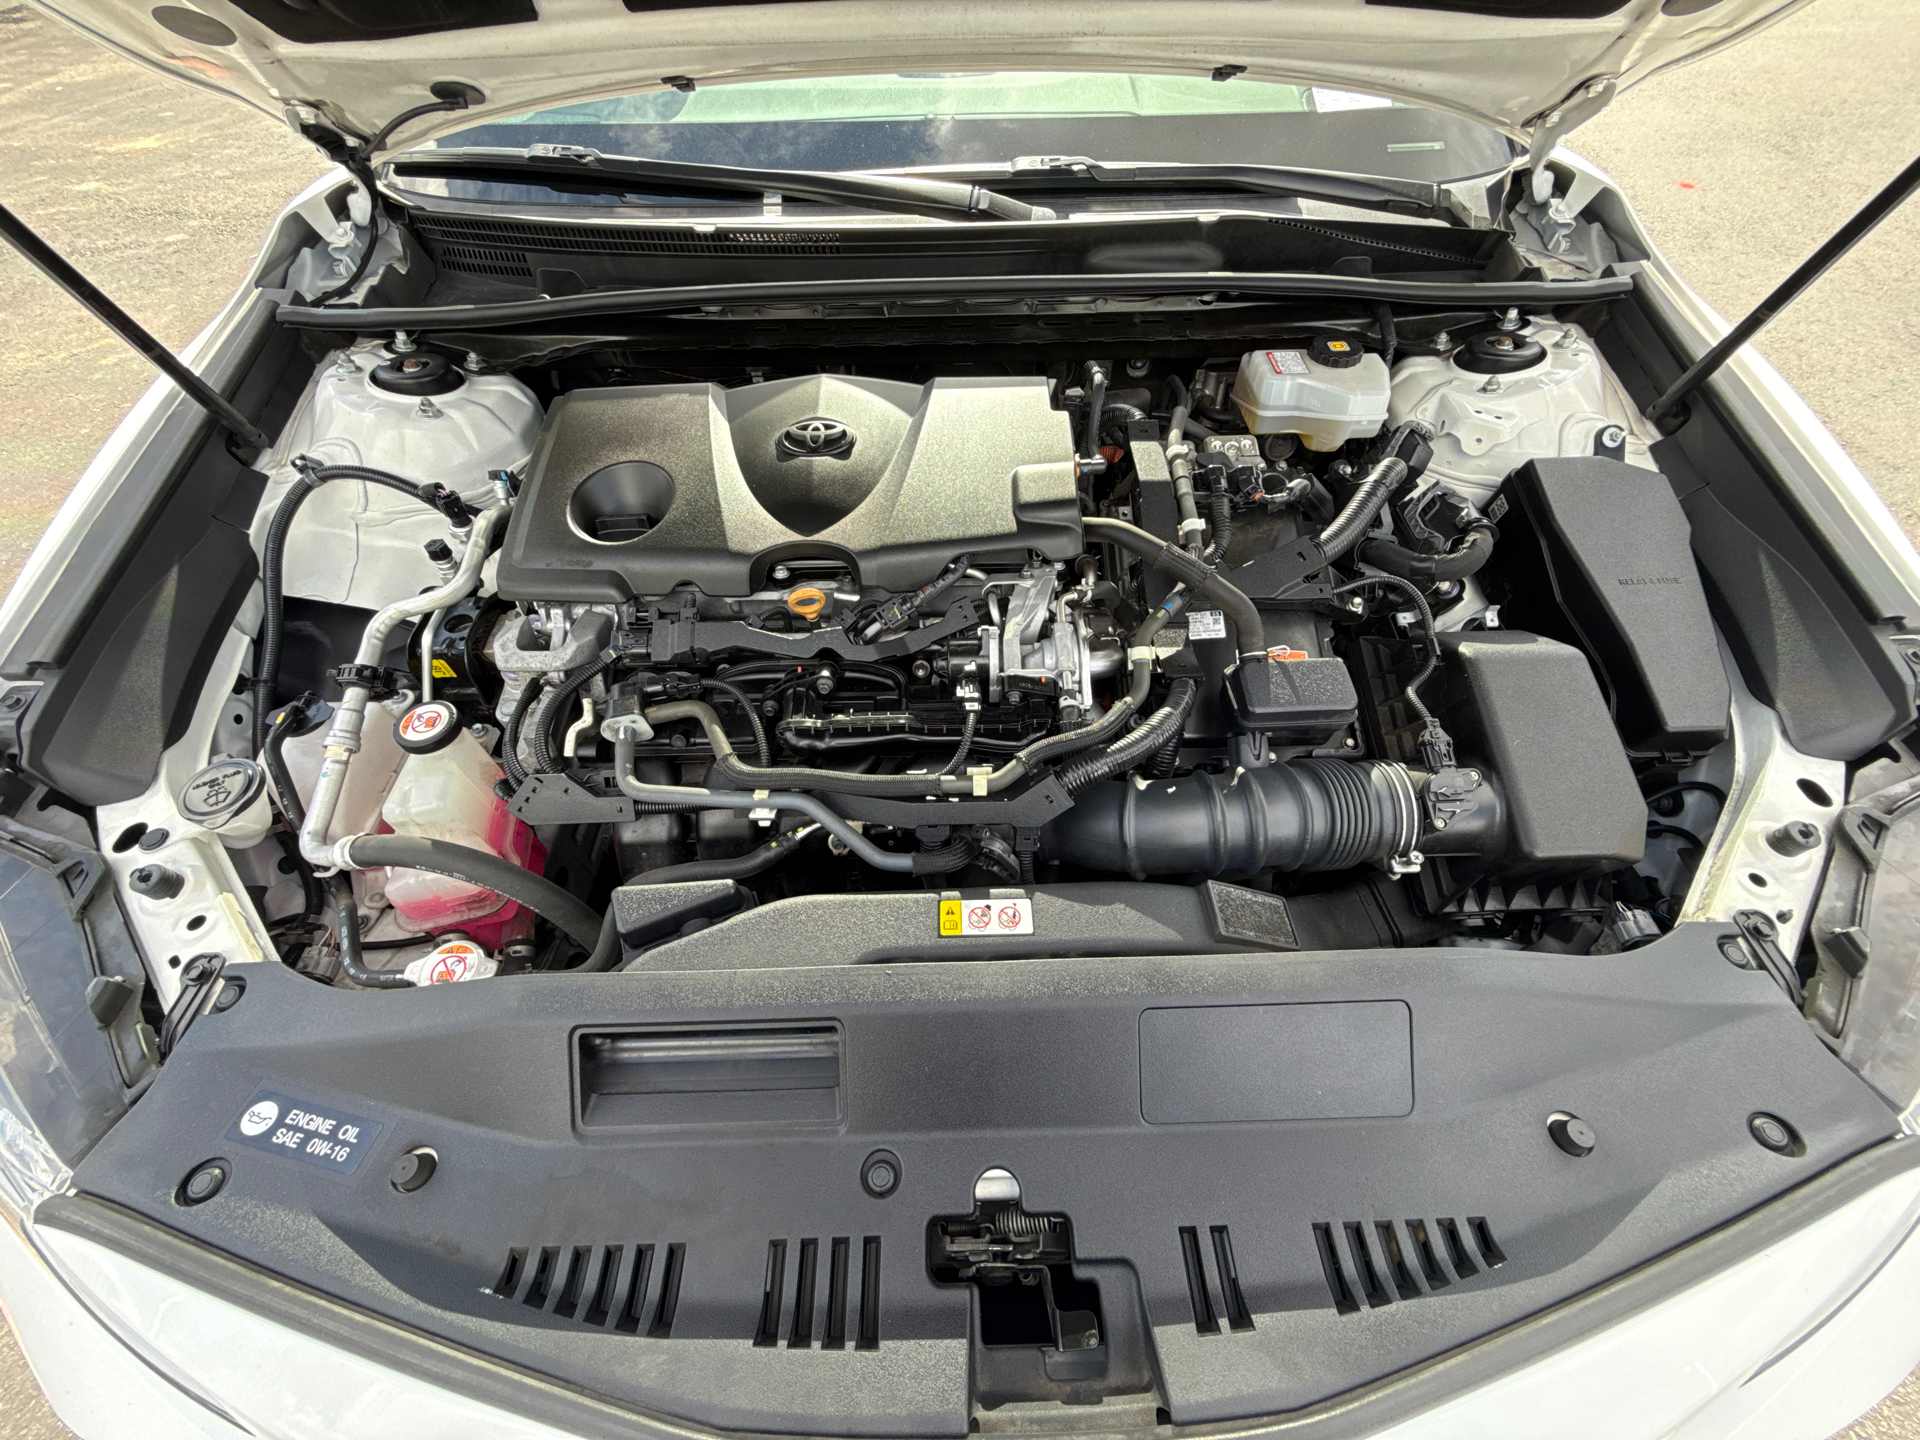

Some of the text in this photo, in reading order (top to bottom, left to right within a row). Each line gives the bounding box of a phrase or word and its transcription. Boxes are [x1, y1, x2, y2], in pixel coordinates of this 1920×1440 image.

[1495, 497, 1507, 515] CB3
[1618, 577, 1647, 585] RELAY
[1657, 577, 1682, 585] FUSE
[284, 1109, 360, 1143] ENGINE OIL
[272, 1128, 350, 1162] SAE 0W-16
